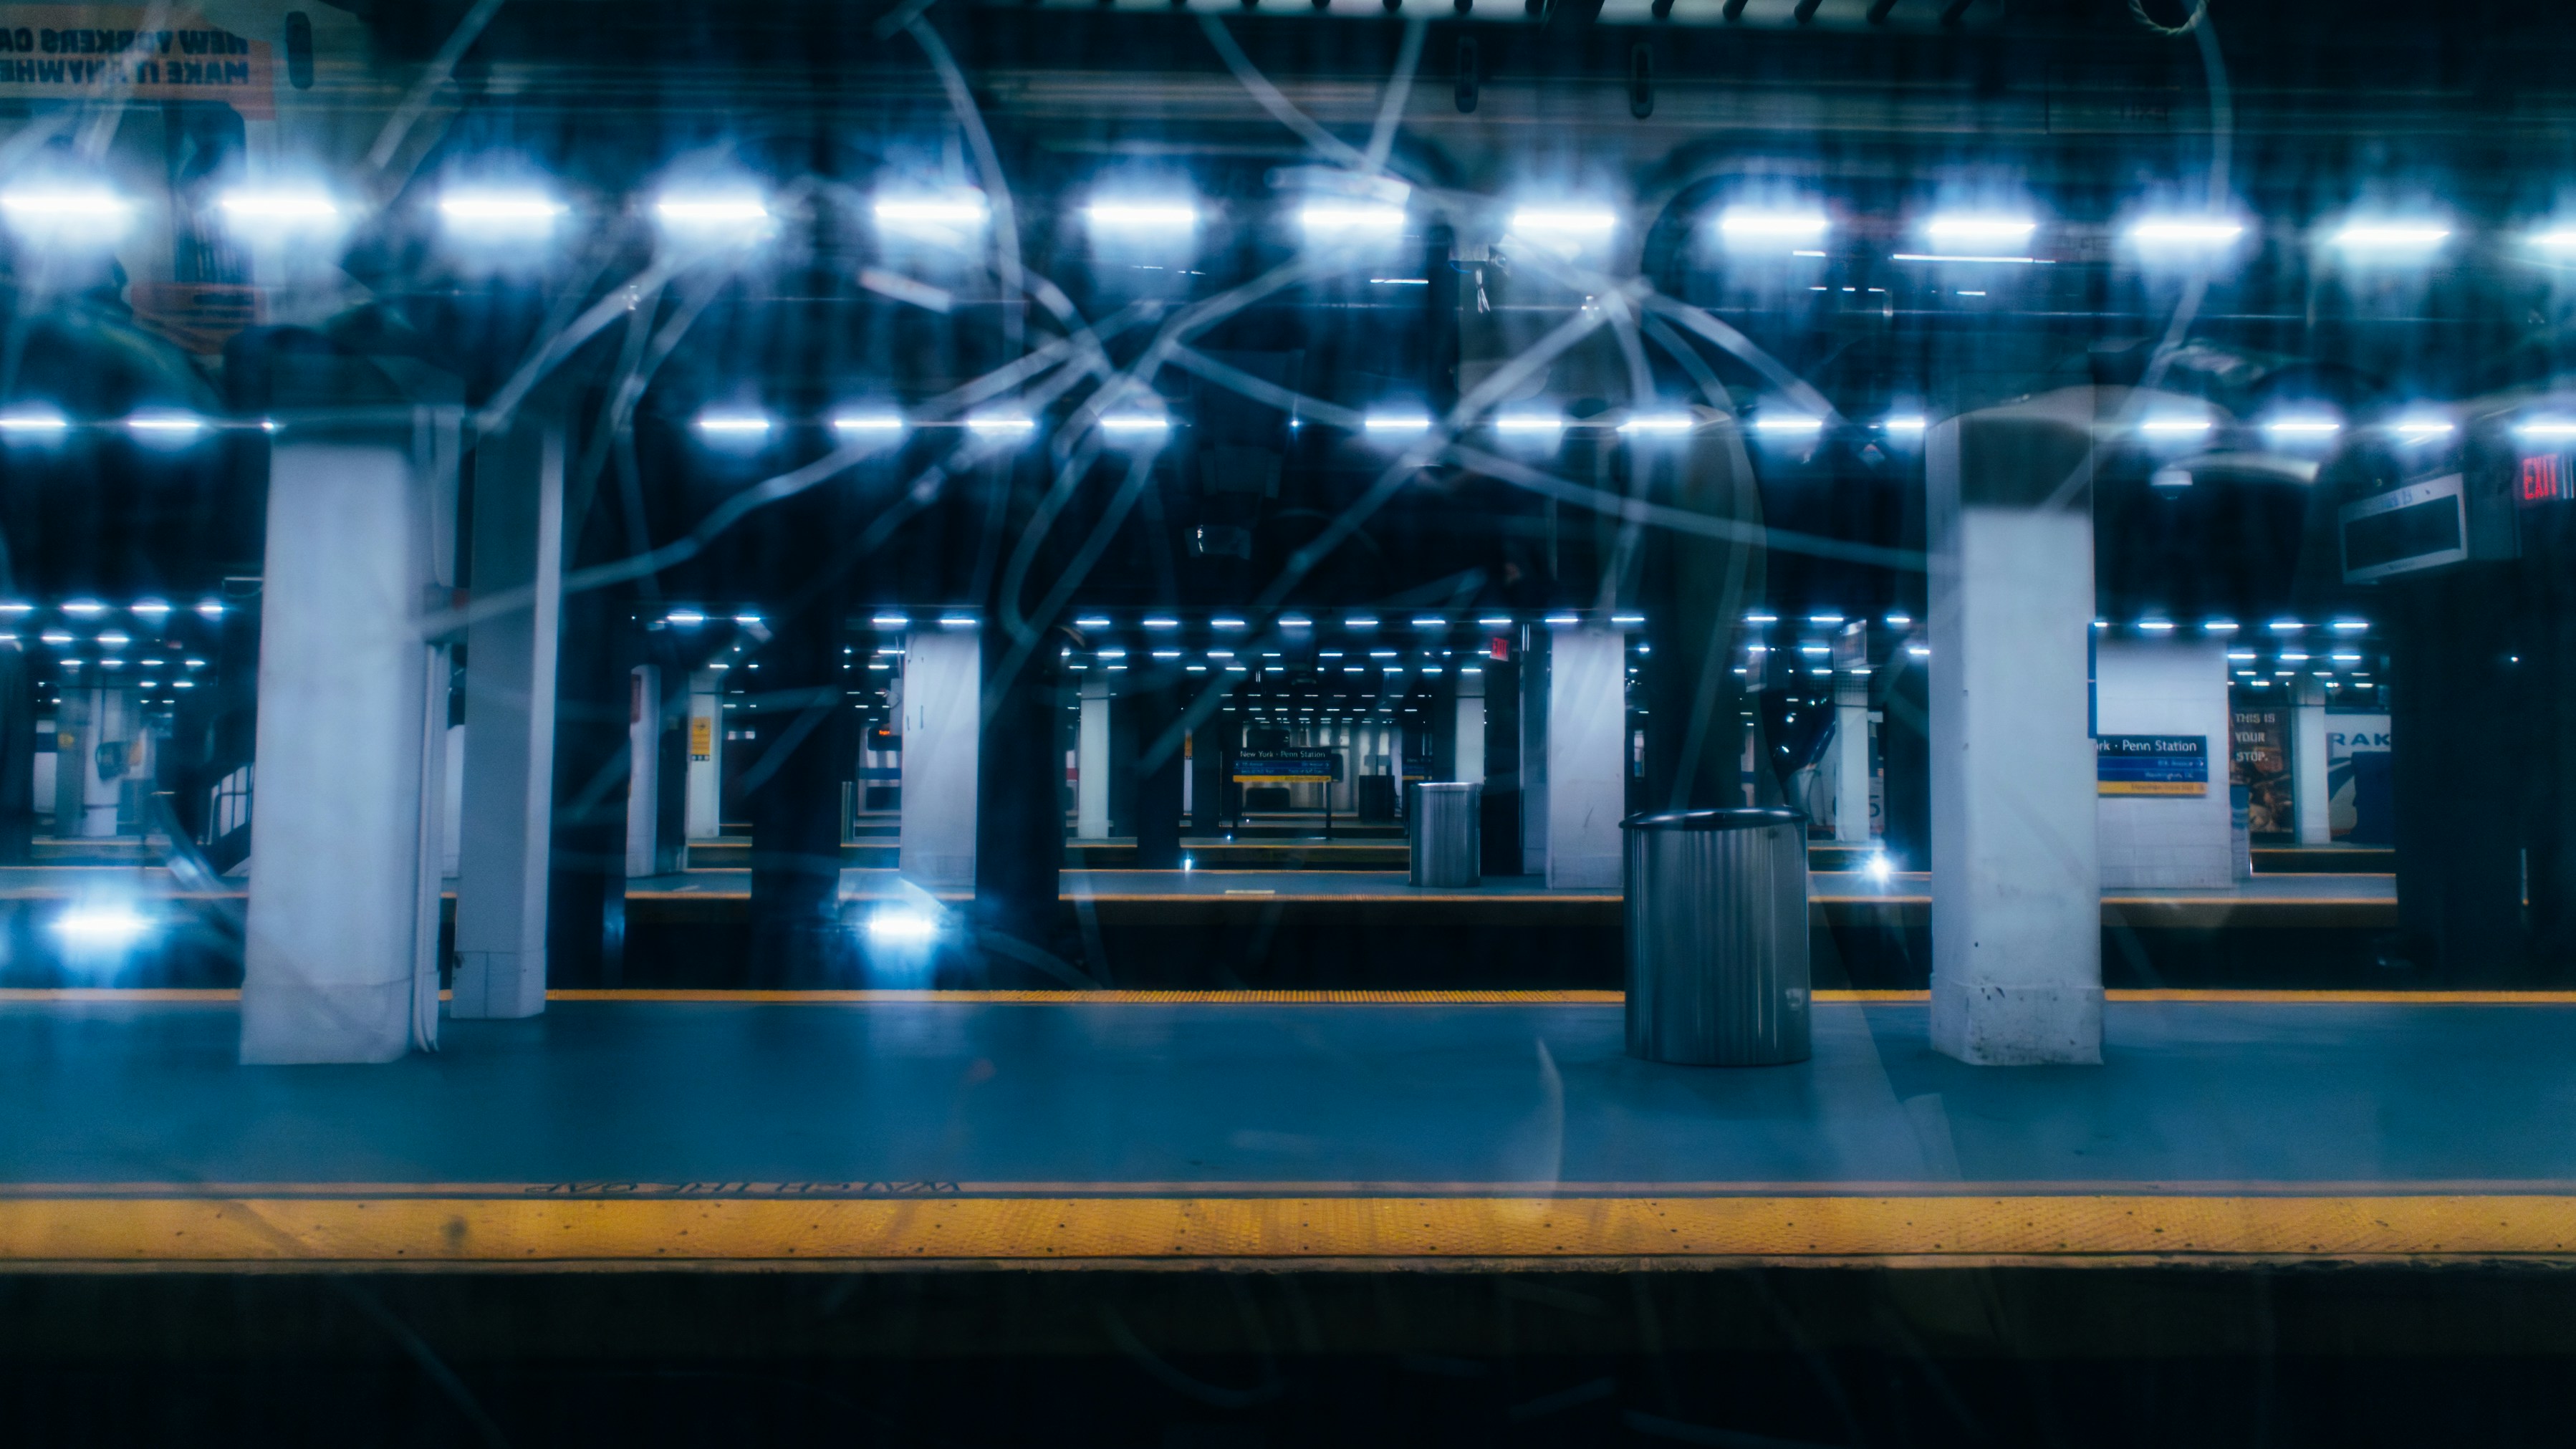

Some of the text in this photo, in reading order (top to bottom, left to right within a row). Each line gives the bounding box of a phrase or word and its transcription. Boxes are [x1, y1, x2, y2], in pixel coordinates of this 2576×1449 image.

[2522, 453, 2558, 500] EXIT
[2235, 713, 2275, 723] THIS IS
[2234, 732, 2266, 743] YOUR
[2095, 738, 2197, 751] rk Penn Station
[2236, 751, 2269, 762] STOP.
